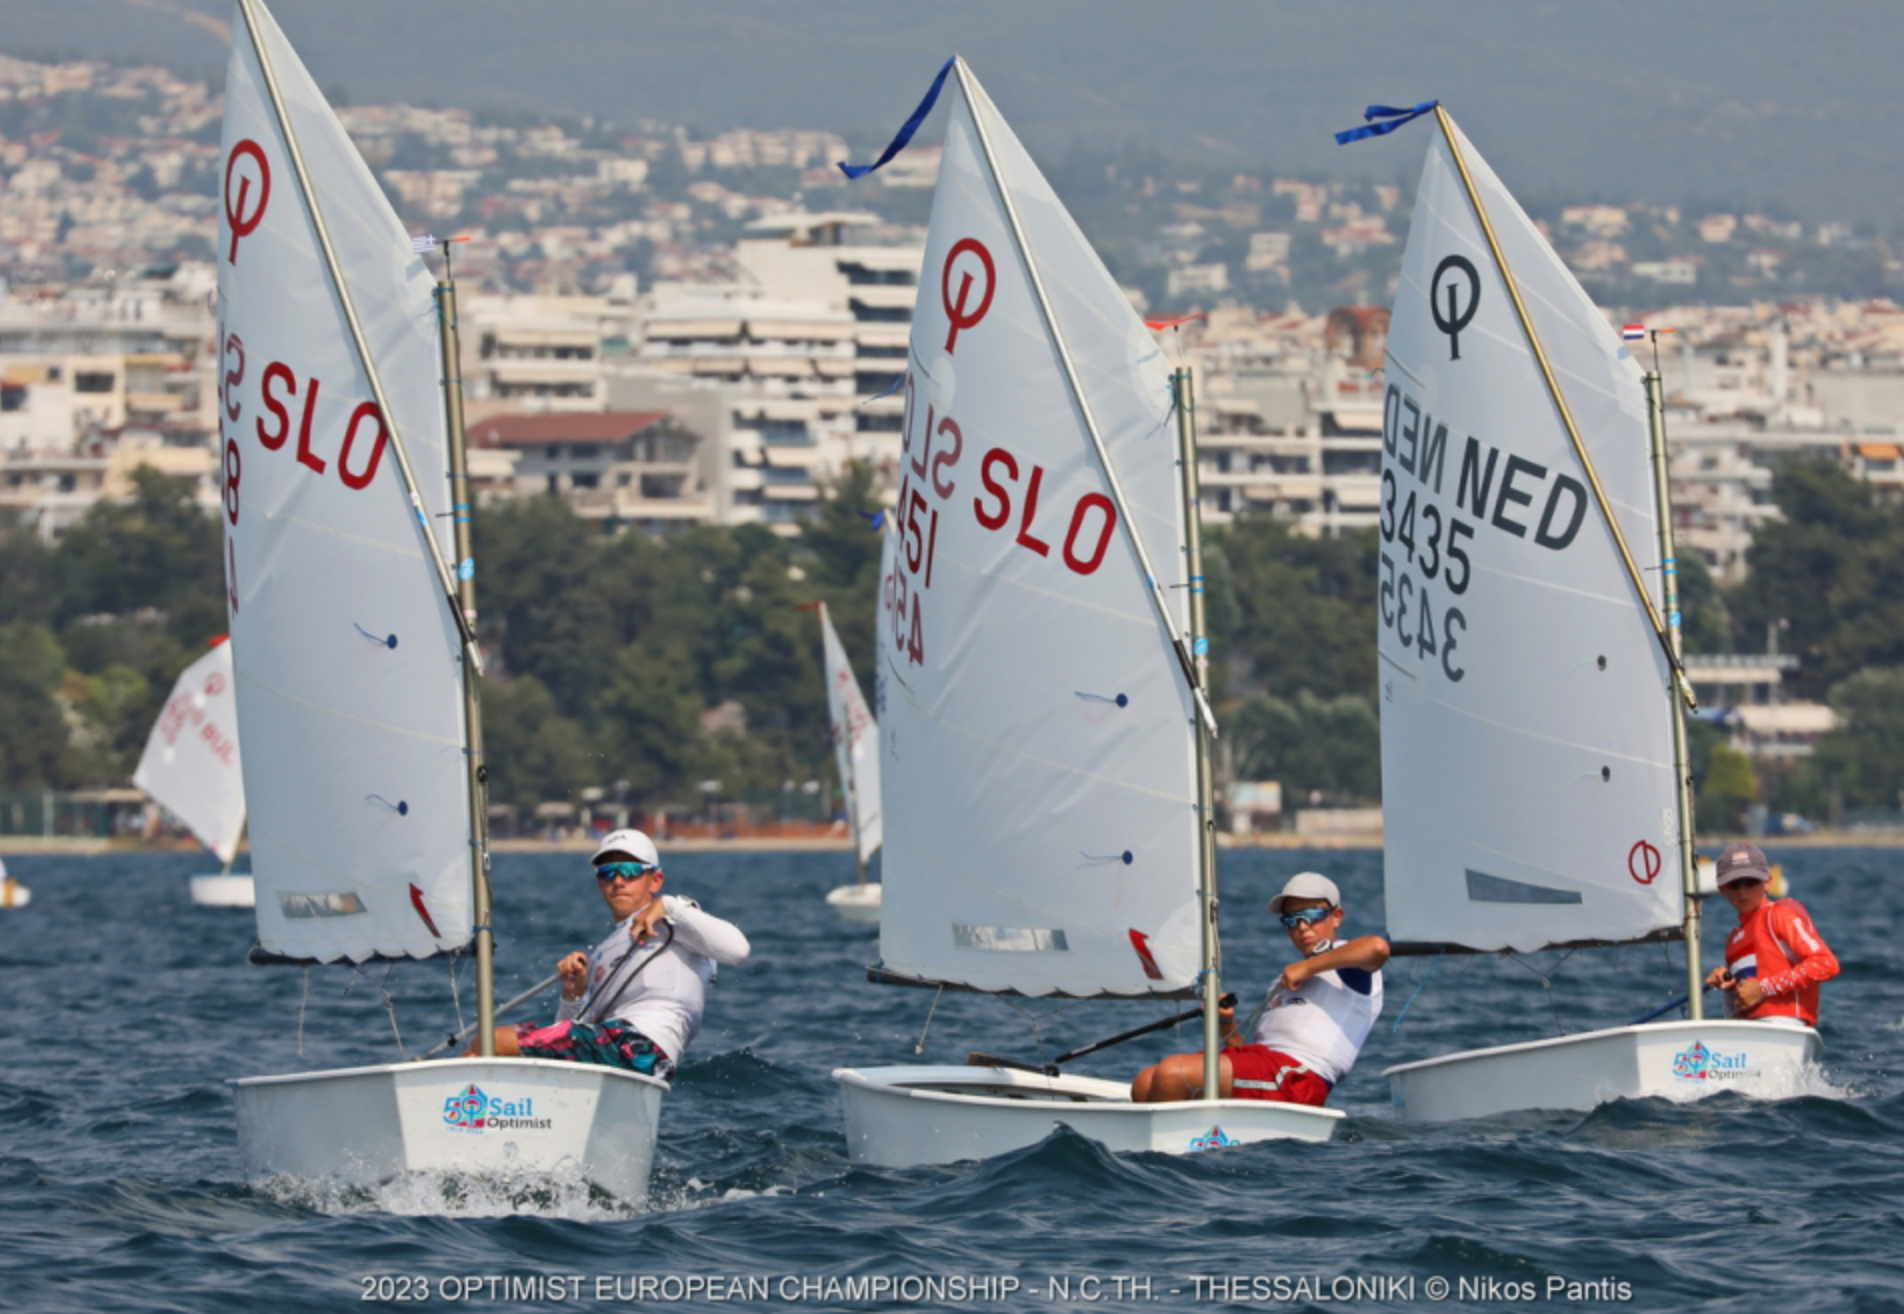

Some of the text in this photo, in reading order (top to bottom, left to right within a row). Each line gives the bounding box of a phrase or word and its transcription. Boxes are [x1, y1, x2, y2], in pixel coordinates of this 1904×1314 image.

[256, 361, 389, 490] SLO
[974, 448, 1117, 575] SLO
[1381, 468, 1474, 596] 3435
[1455, 436, 1588, 551] NED
[489, 1097, 533, 1117] Sail
[1711, 1053, 1746, 1069] Sail
[486, 1117, 552, 1131] Optimist
